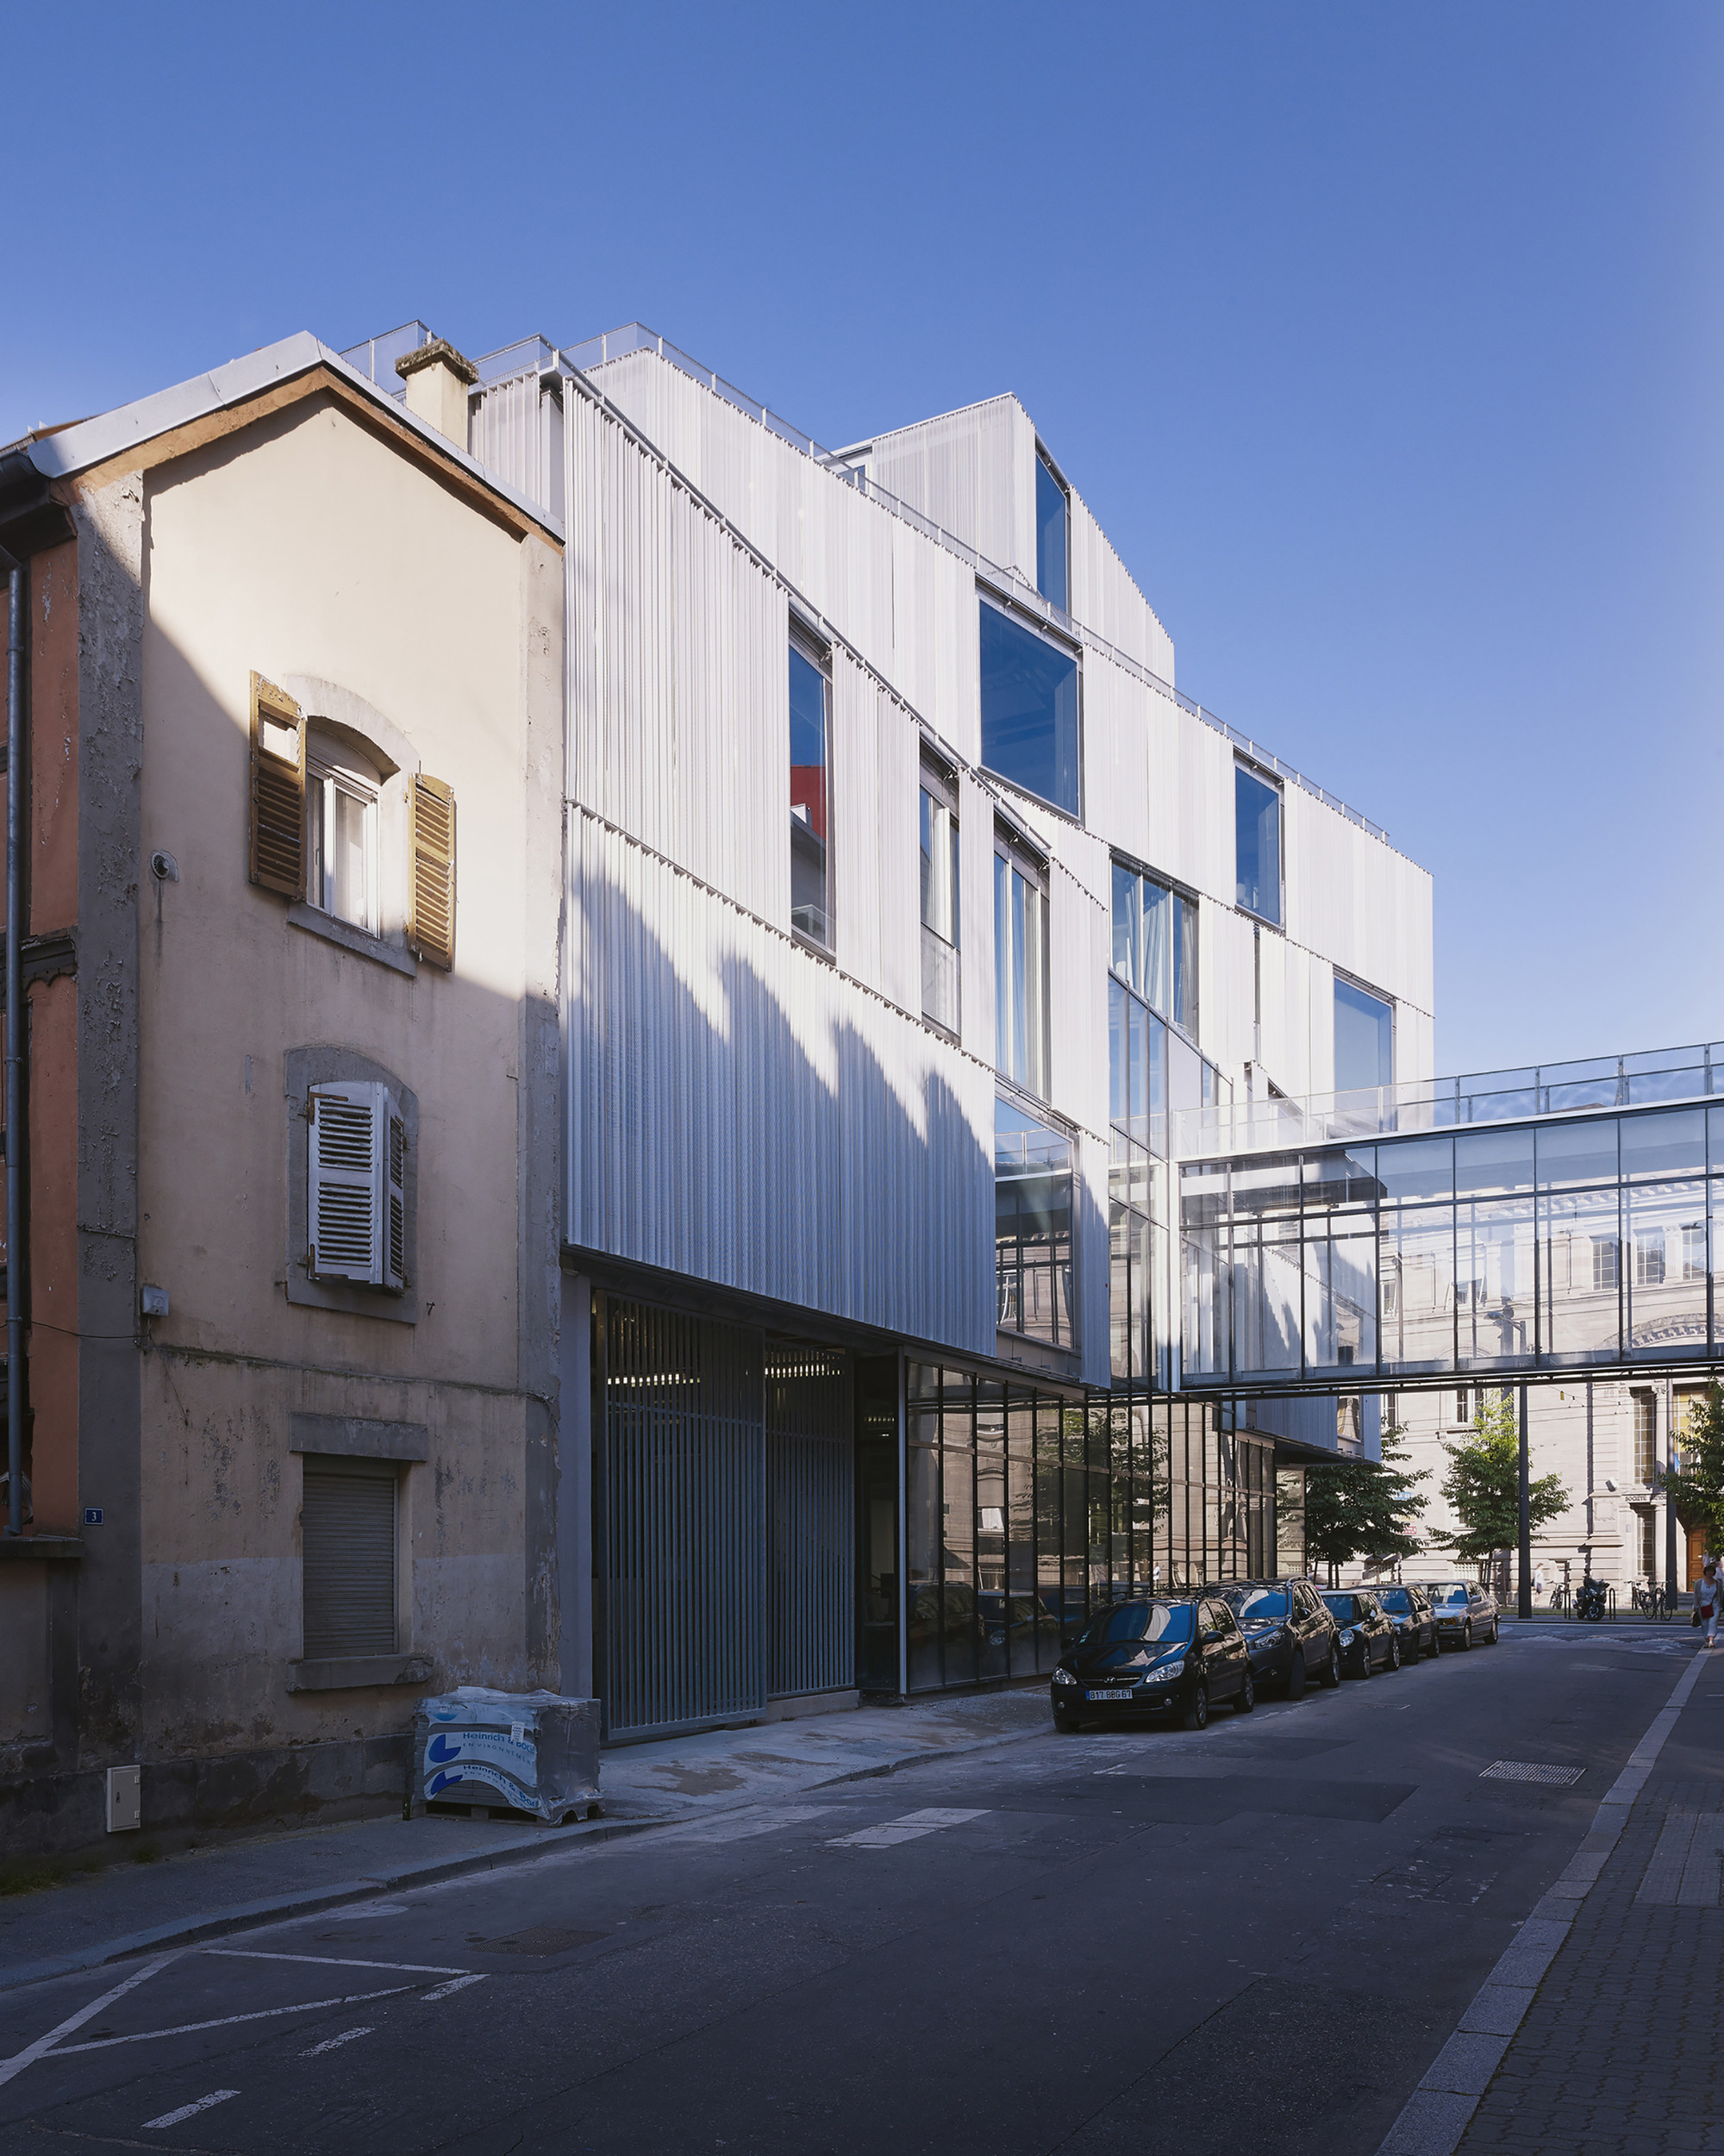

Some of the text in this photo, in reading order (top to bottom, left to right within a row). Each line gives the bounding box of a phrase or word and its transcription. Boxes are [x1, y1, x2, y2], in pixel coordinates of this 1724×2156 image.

[91, 1511, 97, 1522] 3
[1121, 1690, 1131, 1698] 67
[463, 1732, 505, 1742] Heinrich
[463, 1765, 506, 1784] Heinrich
